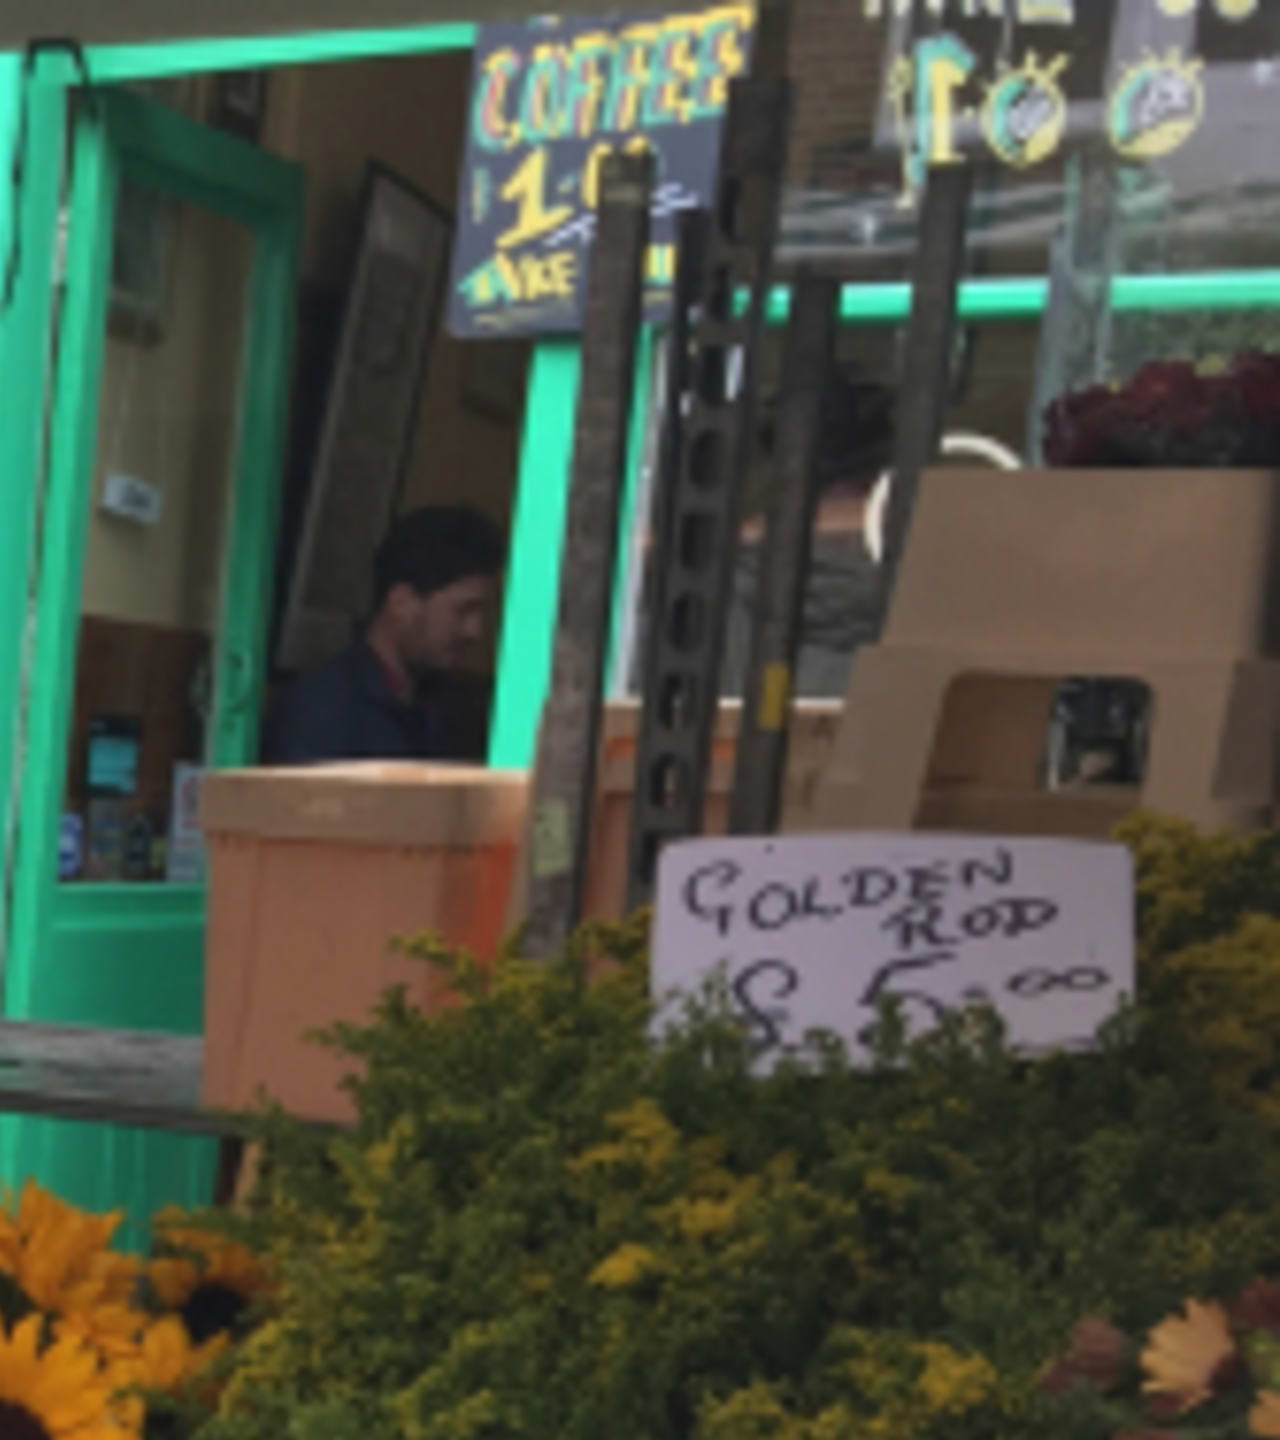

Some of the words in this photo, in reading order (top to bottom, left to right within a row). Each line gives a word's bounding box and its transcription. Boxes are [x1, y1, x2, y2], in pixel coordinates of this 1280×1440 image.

[472, 6, 755, 153] COFFEE
[683, 846, 1016, 938] GOLDEN
[880, 896, 1061, 953] ROD
